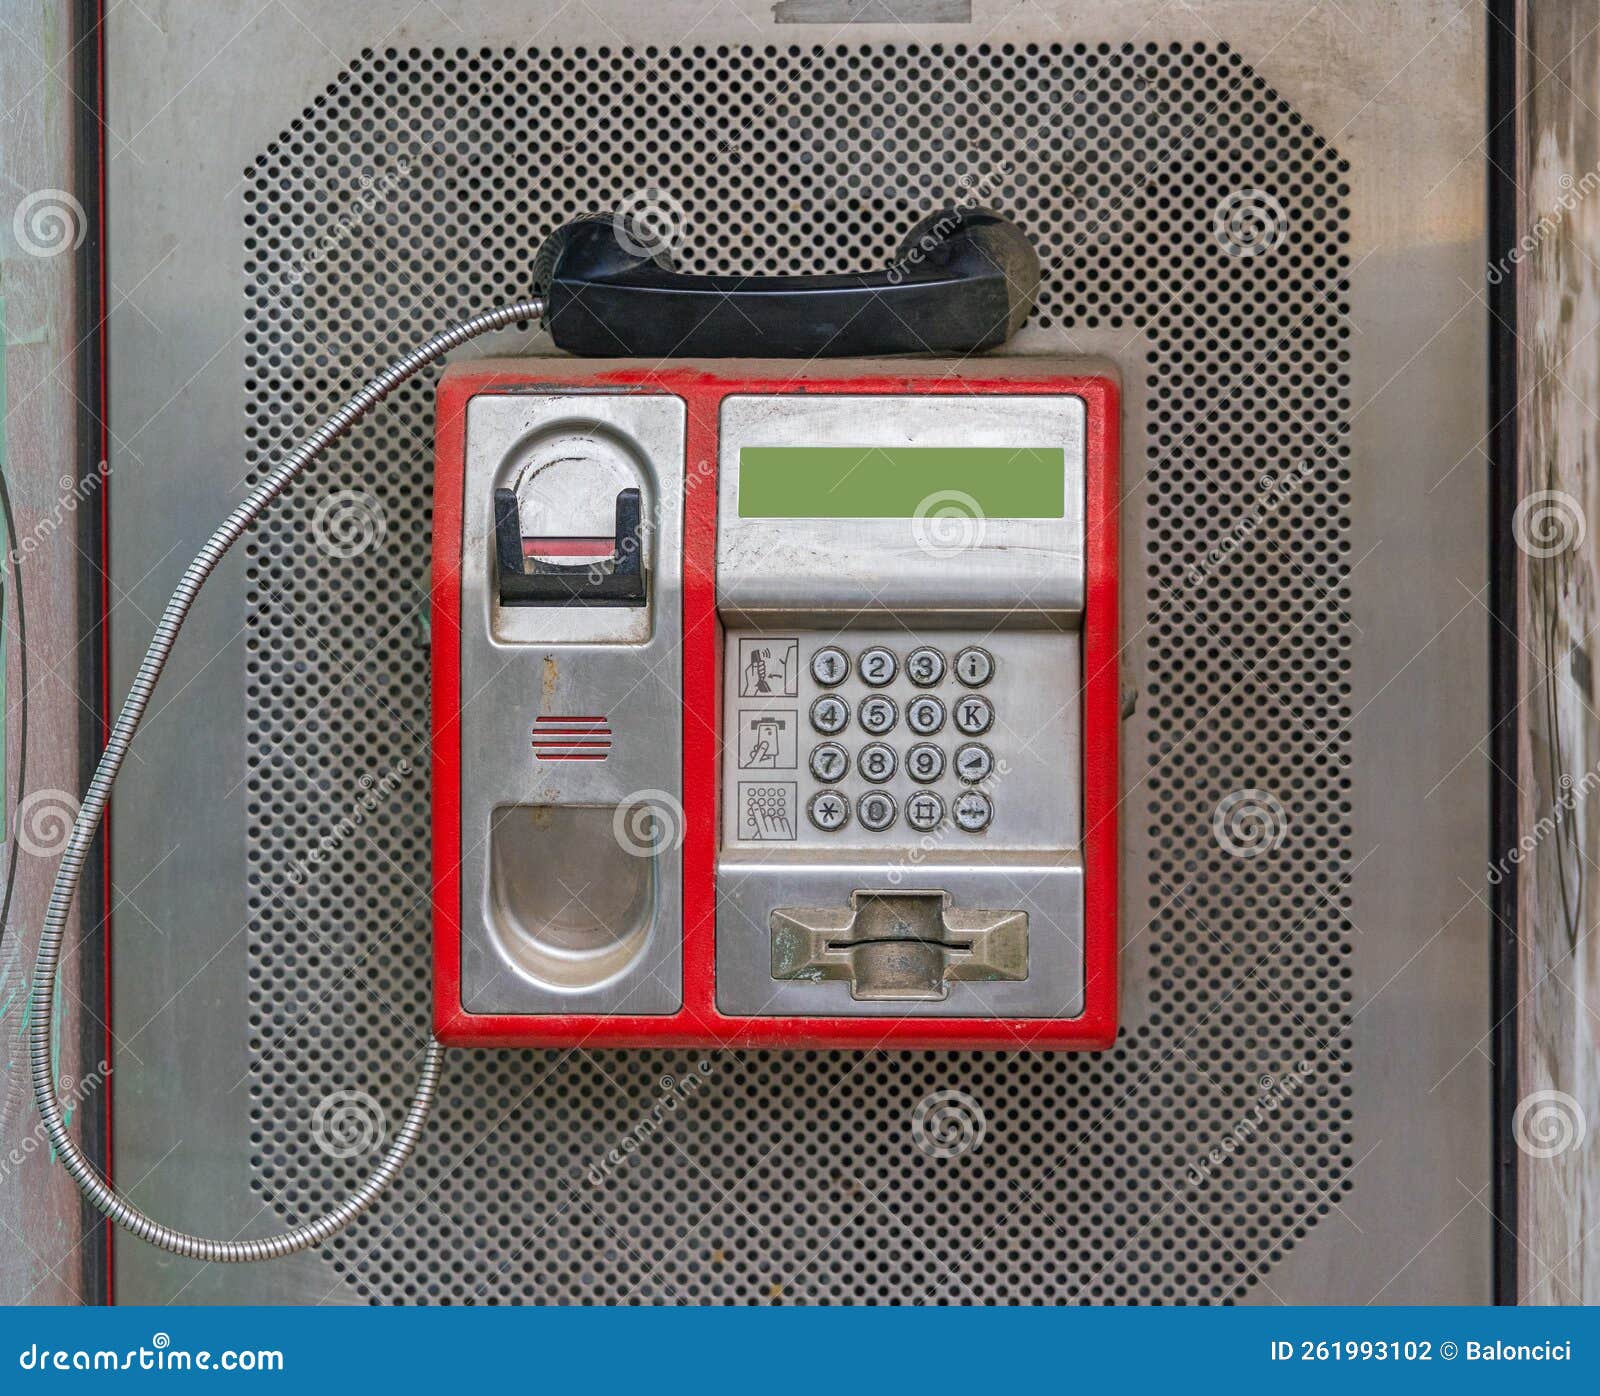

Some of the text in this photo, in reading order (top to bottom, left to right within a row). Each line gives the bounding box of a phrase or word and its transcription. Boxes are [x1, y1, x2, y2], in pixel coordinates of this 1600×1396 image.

[825, 657, 837, 677] 1
[868, 656, 885, 677] 2
[917, 657, 932, 678] 3
[822, 705, 981, 726] 4 5 6 K
[822, 752, 933, 774] 7 8 9
[868, 801, 885, 822] 0
